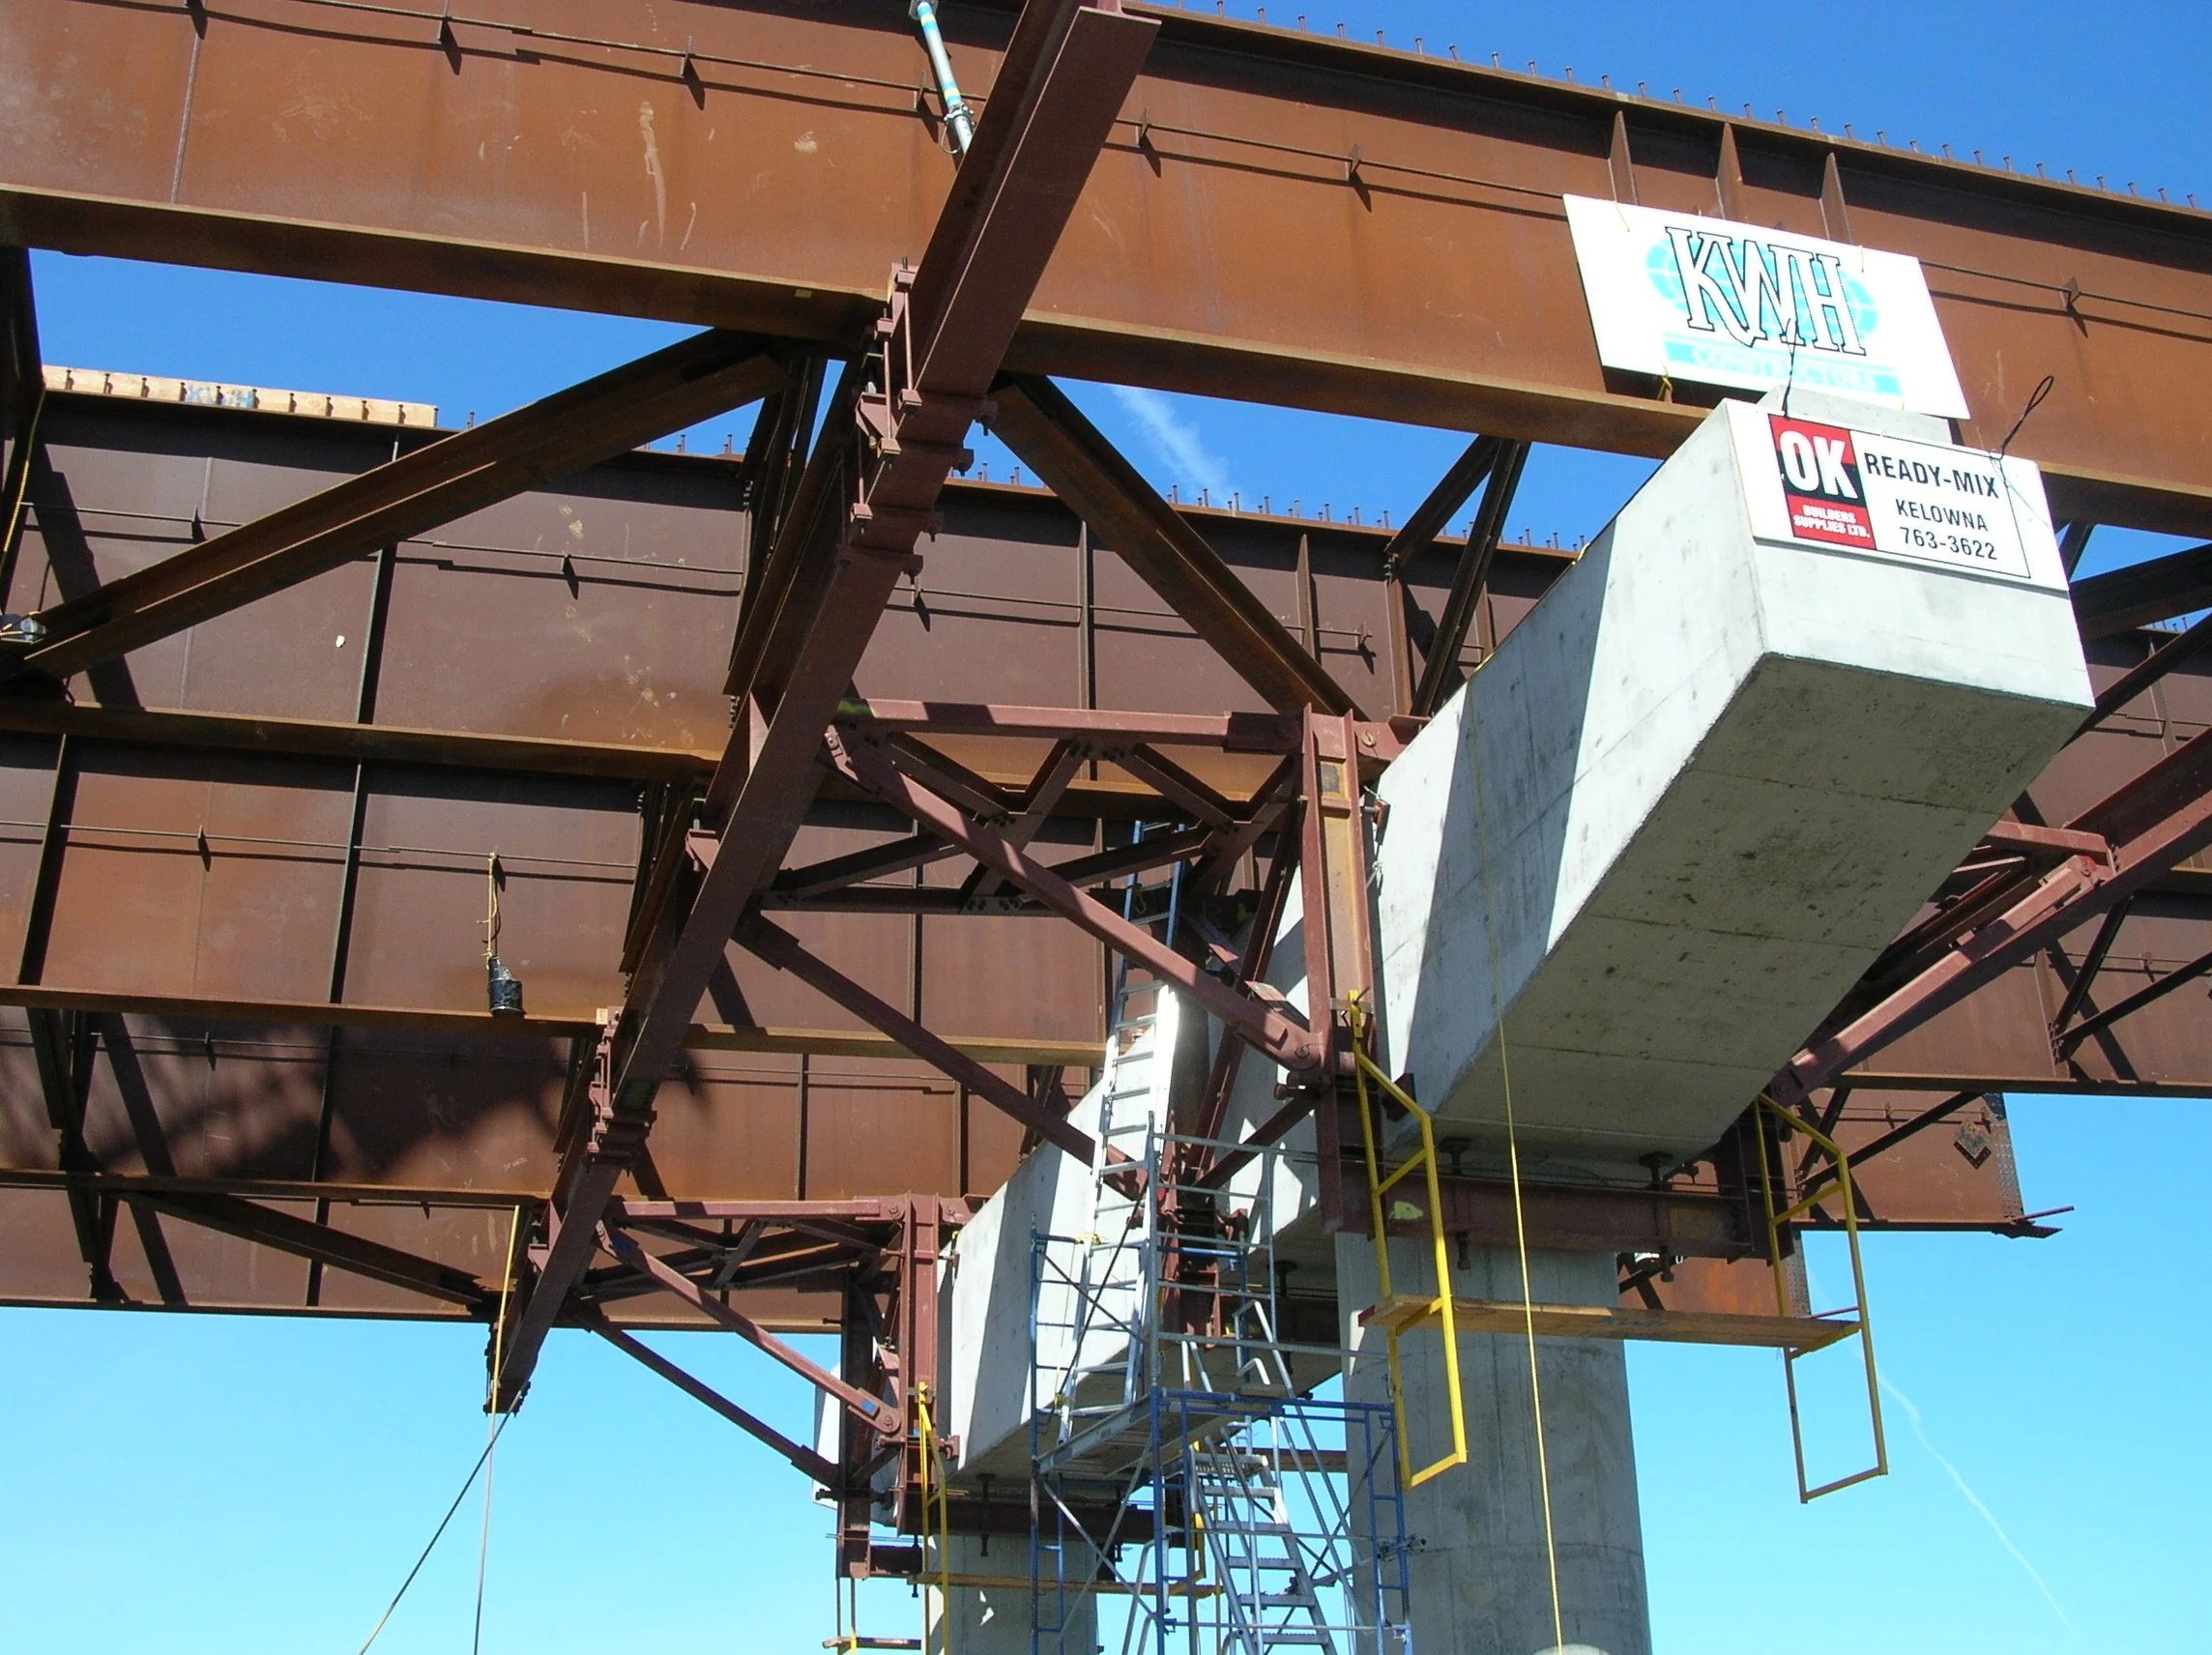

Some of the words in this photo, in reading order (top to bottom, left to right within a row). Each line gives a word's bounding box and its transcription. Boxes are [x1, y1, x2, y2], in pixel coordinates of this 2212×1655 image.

[1665, 226, 1867, 356] KWH
[1780, 430, 1858, 499] OK
[1864, 452, 1998, 499] READY-MIX
[1792, 513, 1847, 535] SUPPLIES
[1896, 499, 1989, 532] KELOWNA
[1900, 526, 1998, 560] 763-3622
